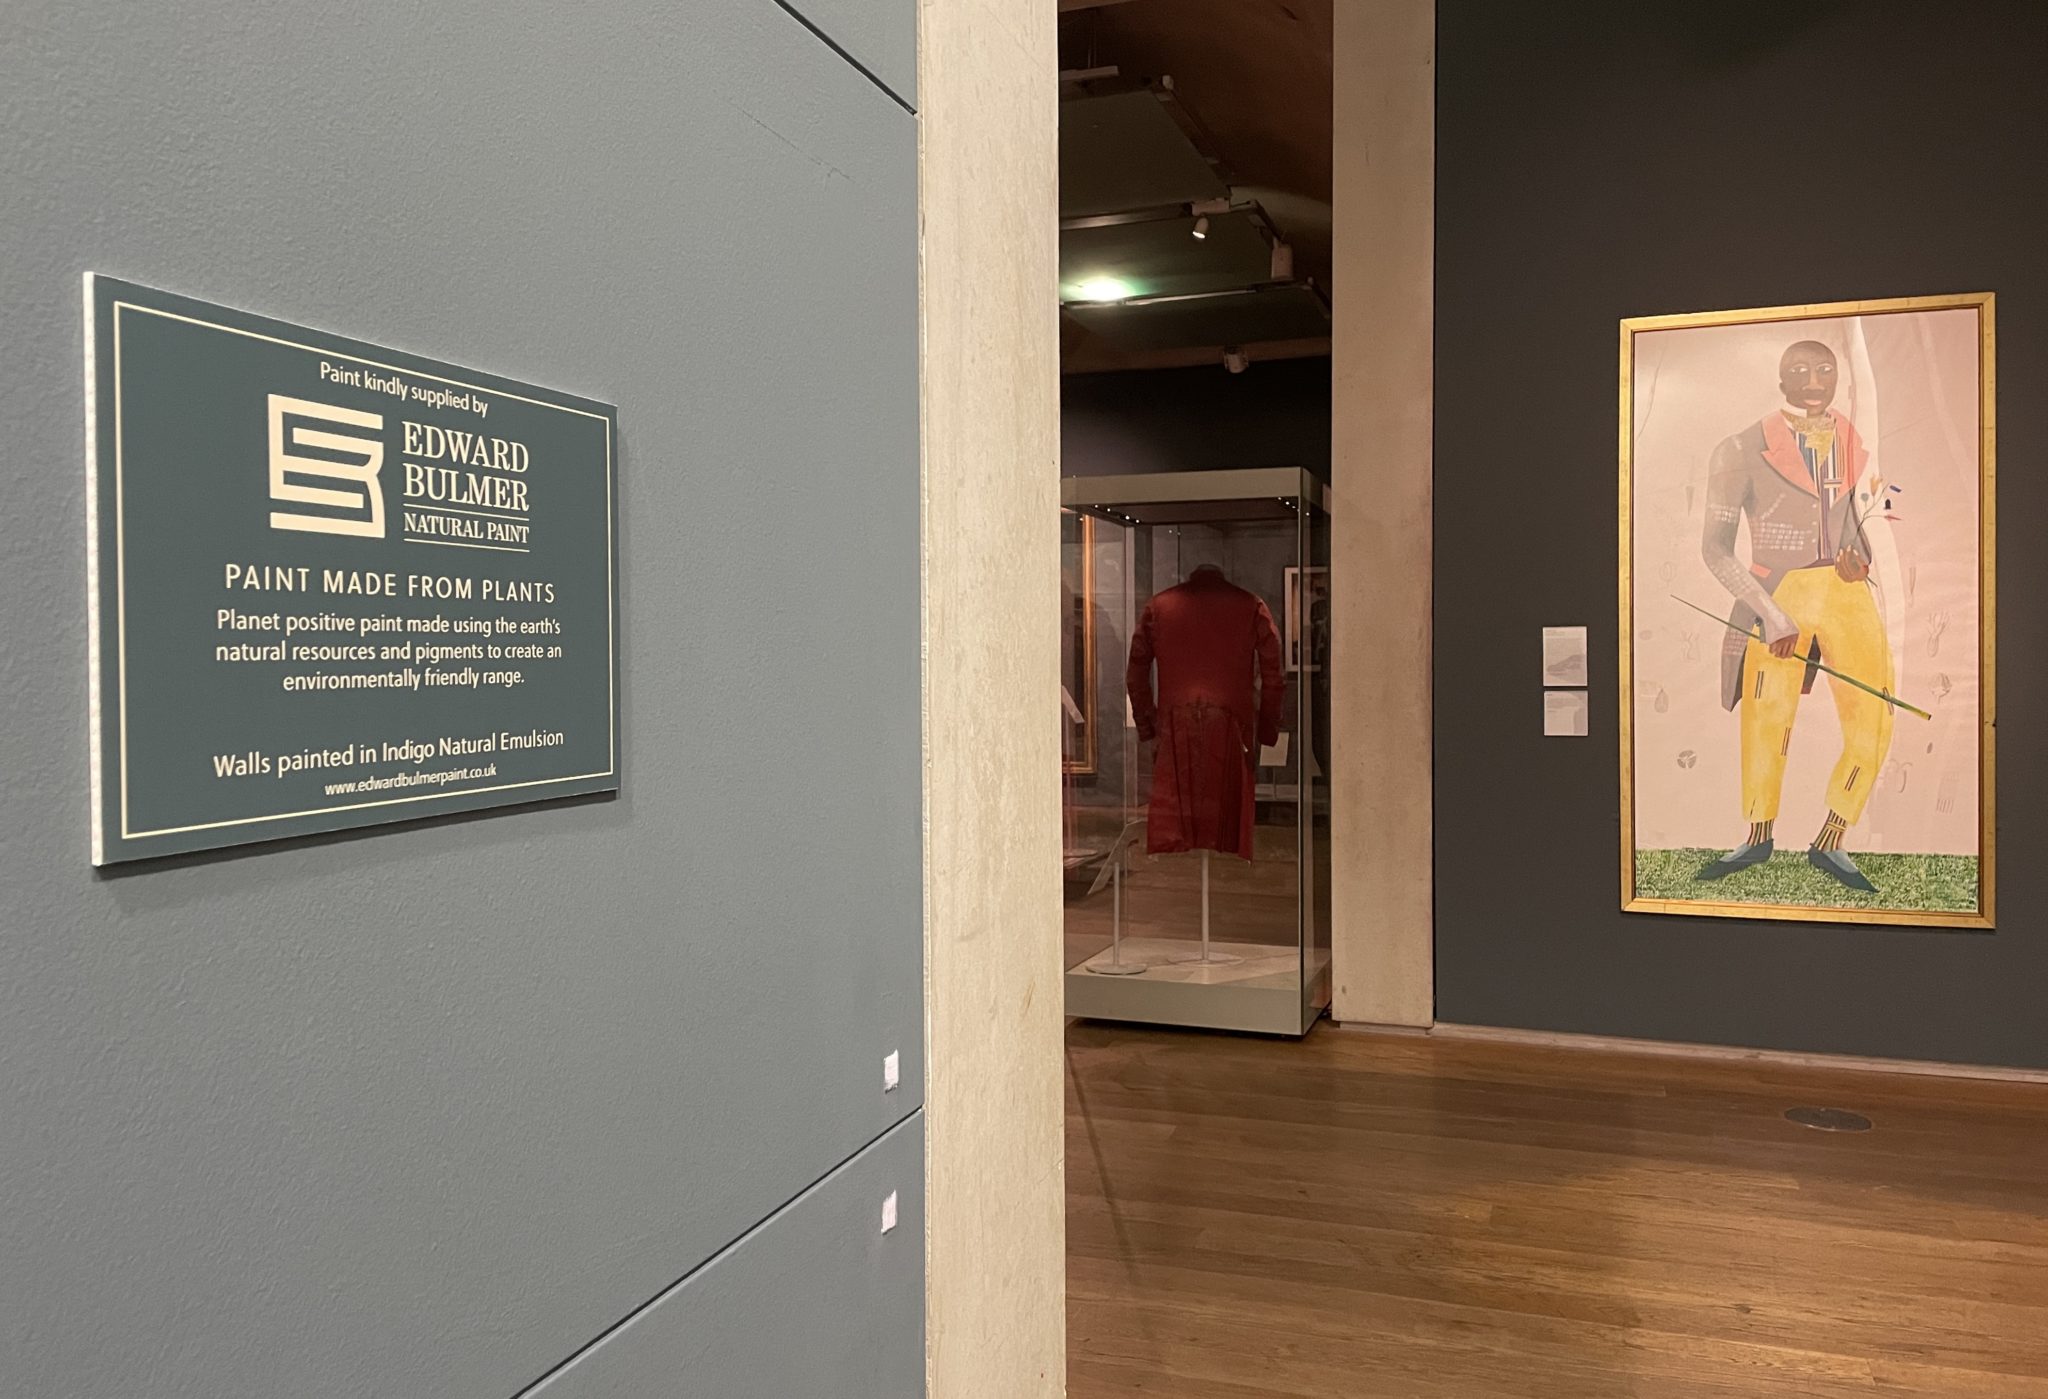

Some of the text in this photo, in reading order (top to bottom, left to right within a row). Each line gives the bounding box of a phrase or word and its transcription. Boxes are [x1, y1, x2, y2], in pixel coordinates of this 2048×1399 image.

[321, 361, 488, 418] Paint kindly supplied by
[402, 420, 529, 473] EDWARD
[402, 462, 530, 512] BULMER
[403, 512, 530, 544] NATURAL PAINT
[225, 563, 555, 604] PAINT MADE FROM PLANTS
[217, 608, 281, 631] Planet
[286, 612, 356, 637] positive
[360, 613, 404, 637] paint
[406, 614, 450, 633] made
[453, 616, 492, 638] using
[494, 616, 518, 634] the
[216, 639, 562, 665] natural resources and pigments to create an
[282, 666, 525, 691] environmentally friendly range.
[213, 728, 564, 779] Walls painted in Indigo Natural Emulsion
[324, 762, 497, 796] www.edwardbulmerpaint.co.uk
